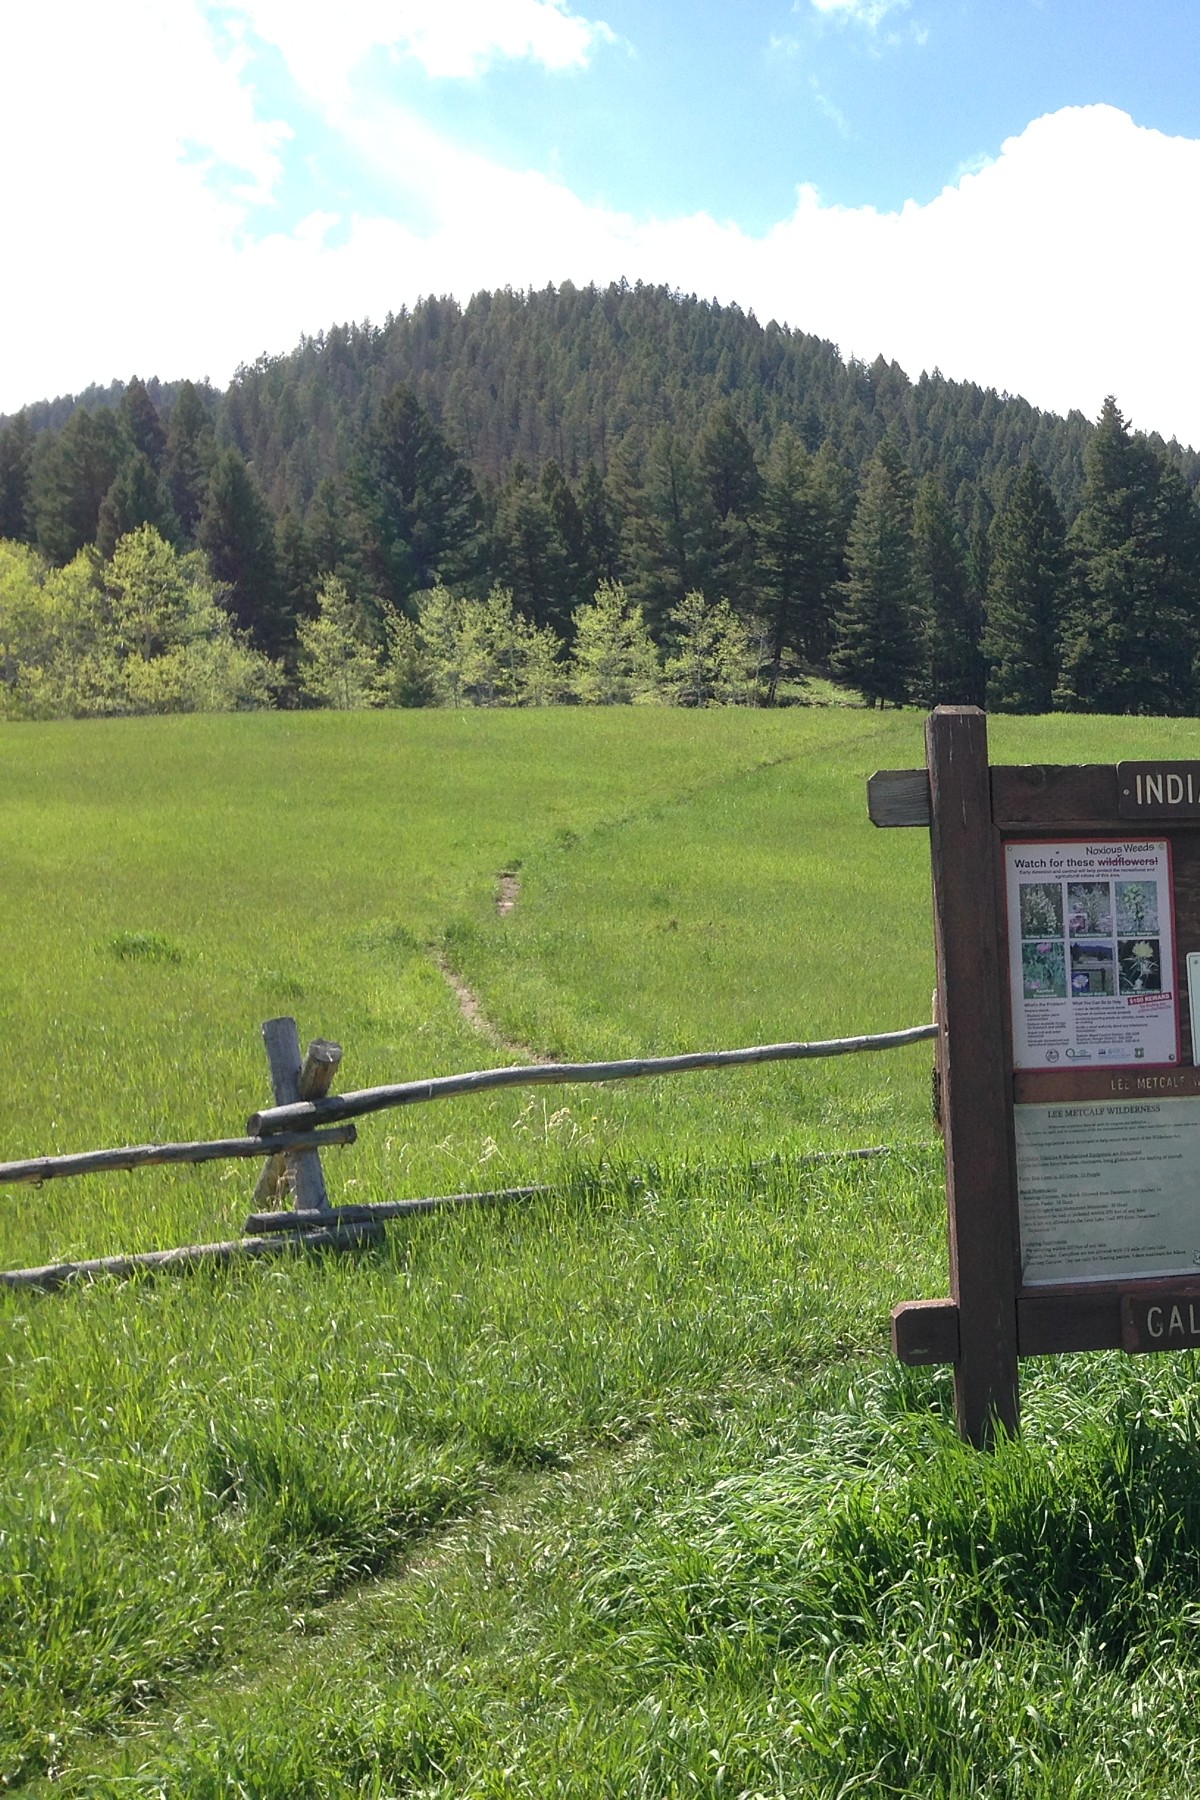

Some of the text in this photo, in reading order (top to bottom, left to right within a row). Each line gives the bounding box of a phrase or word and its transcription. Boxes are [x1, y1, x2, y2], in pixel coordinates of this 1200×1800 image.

[1086, 844, 1155, 855] Noxious Weeds
[1014, 859, 1046, 868] Watch
[1049, 858, 1064, 867] for
[1067, 858, 1094, 867] these
[1111, 1078, 1130, 1090] LEE
[1137, 1076, 1185, 1089] METCALF
[1047, 1104, 1161, 1118] LEE METCALF WILDERNESS
